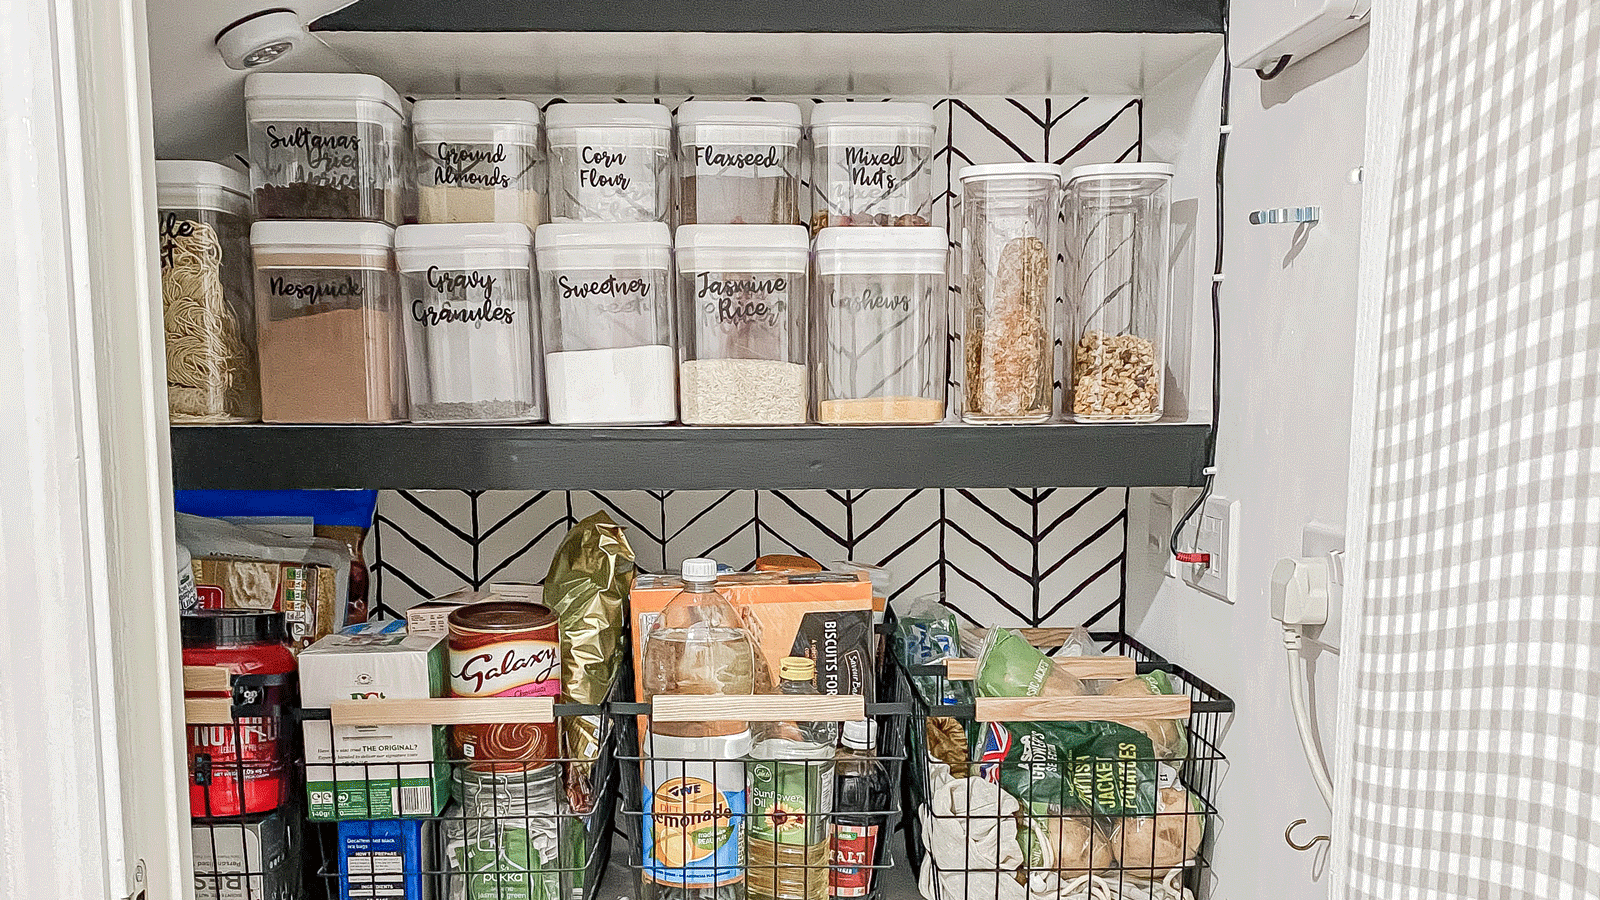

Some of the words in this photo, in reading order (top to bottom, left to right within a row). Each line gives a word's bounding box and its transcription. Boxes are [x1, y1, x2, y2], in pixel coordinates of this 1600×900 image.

[266, 125, 361, 151] Sultanas
[437, 142, 507, 164] Ground
[582, 146, 627, 168] Corn
[695, 145, 780, 168] Flaxseed
[846, 146, 904, 166] Mixed
[434, 167, 511, 188] Almonds
[580, 169, 631, 190] Flour
[269, 277, 364, 304] Nesquick
[427, 265, 497, 299] Gravy
[558, 275, 651, 299] Sweetner
[697, 271, 787, 298] Jasmine
[412, 299, 515, 325] Granules
[718, 298, 768, 324] Rice
[824, 621, 837, 672] BISCUITS
[450, 647, 560, 693] Galaxy
[378, 744, 418, 752] ORIGINAL?
[753, 797, 767, 808] Oil
